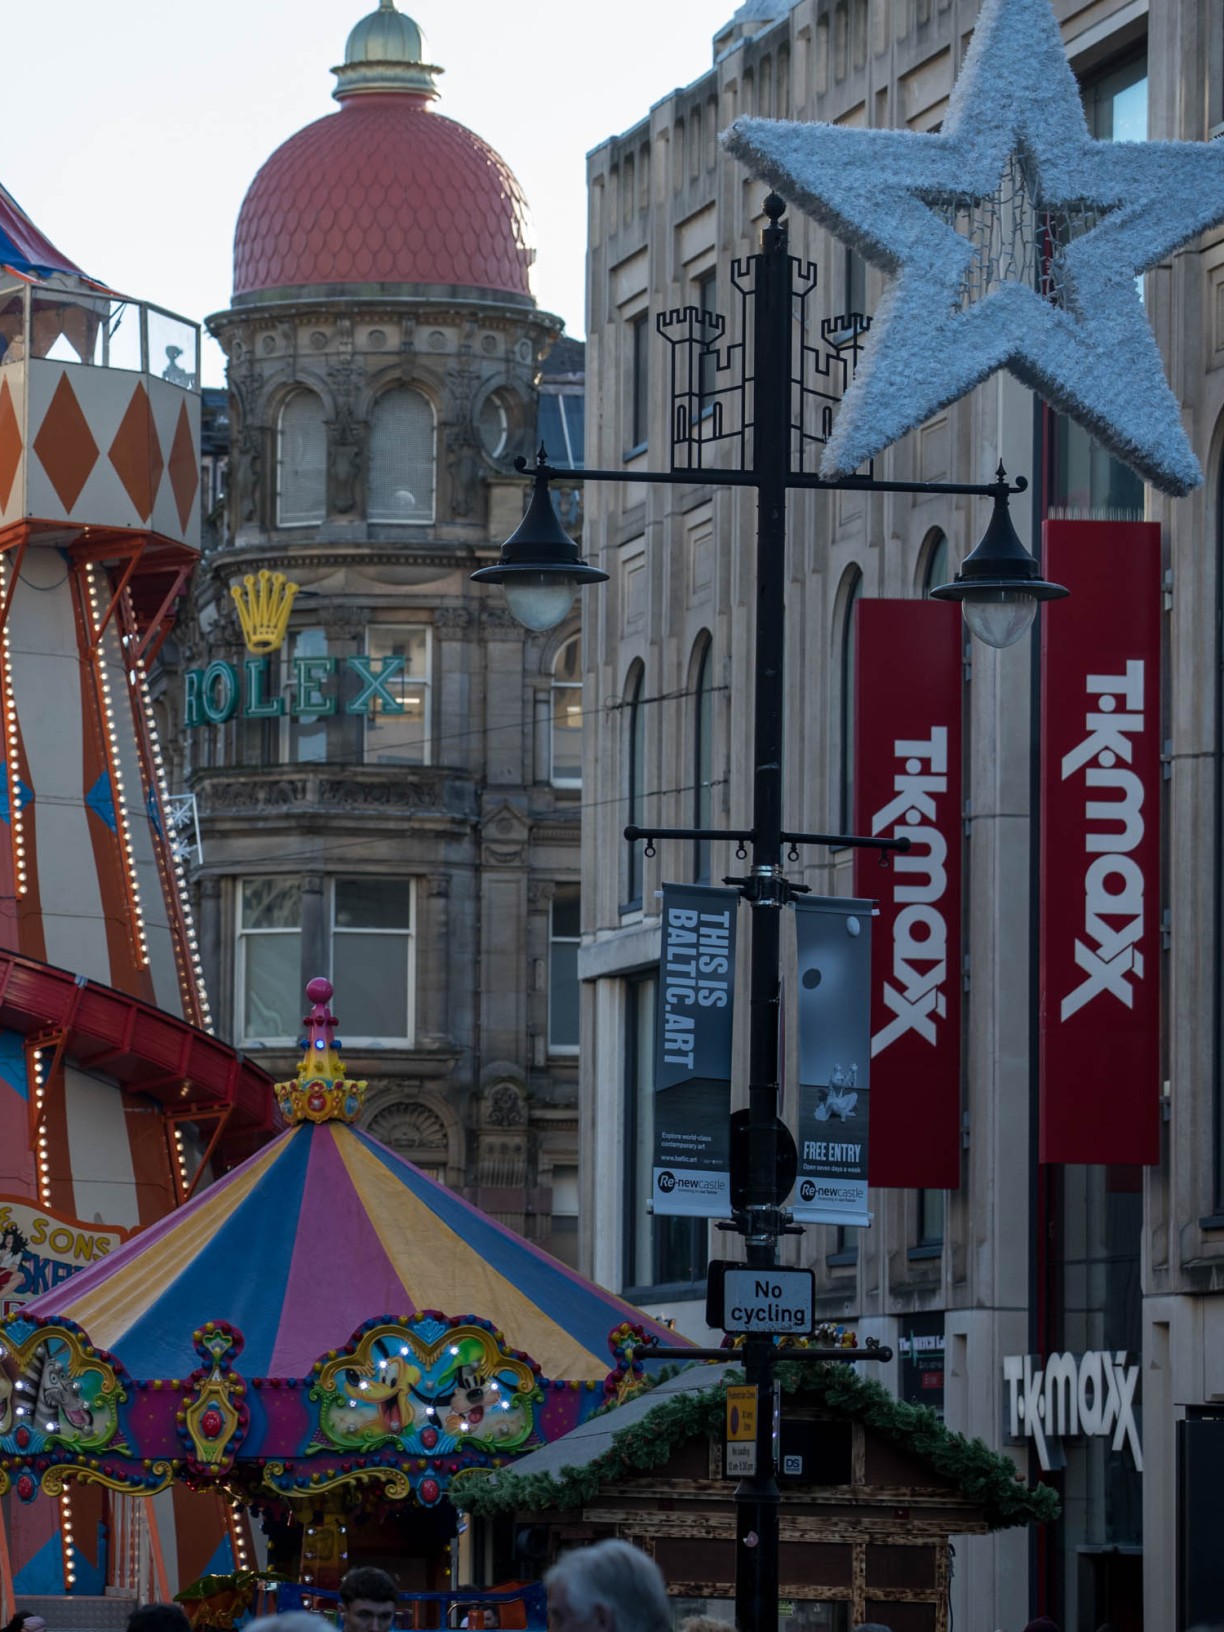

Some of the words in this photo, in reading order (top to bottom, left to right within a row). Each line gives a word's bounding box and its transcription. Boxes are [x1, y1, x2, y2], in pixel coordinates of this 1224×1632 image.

[184, 655, 405, 728] ROLEX
[698, 911, 730, 974] THIS
[664, 908, 698, 1070] BALTIC.ART
[697, 979, 728, 1008] IS
[661, 1131, 681, 1140] Explore
[803, 1141, 827, 1160] FREE
[828, 1142, 862, 1163] ENTRY
[802, 1163, 816, 1171] Open
[31, 1218, 110, 1261] SONS
[755, 1280, 782, 1298] No
[731, 1303, 805, 1326] cycling
[786, 1458, 800, 1468] DS
